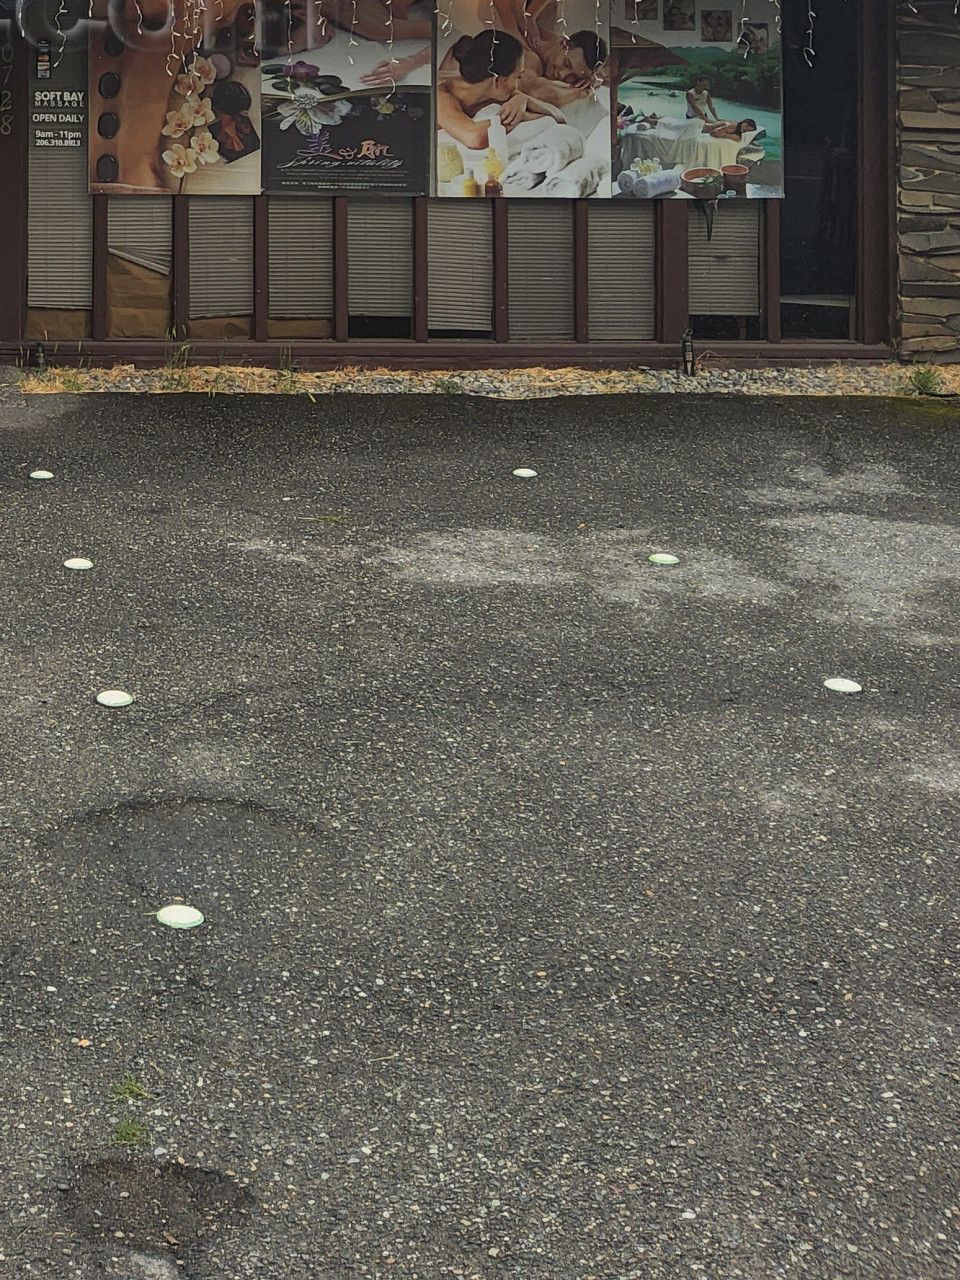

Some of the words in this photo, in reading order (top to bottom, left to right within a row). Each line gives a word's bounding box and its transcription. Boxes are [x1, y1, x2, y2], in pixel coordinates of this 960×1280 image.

[34, 91, 61, 101] SOFT
[63, 91, 85, 101] BAY
[32, 113, 57, 122] OPEN
[58, 113, 85, 123] DAILY
[35, 130, 54, 138] 9am
[59, 130, 82, 139] 11pm
